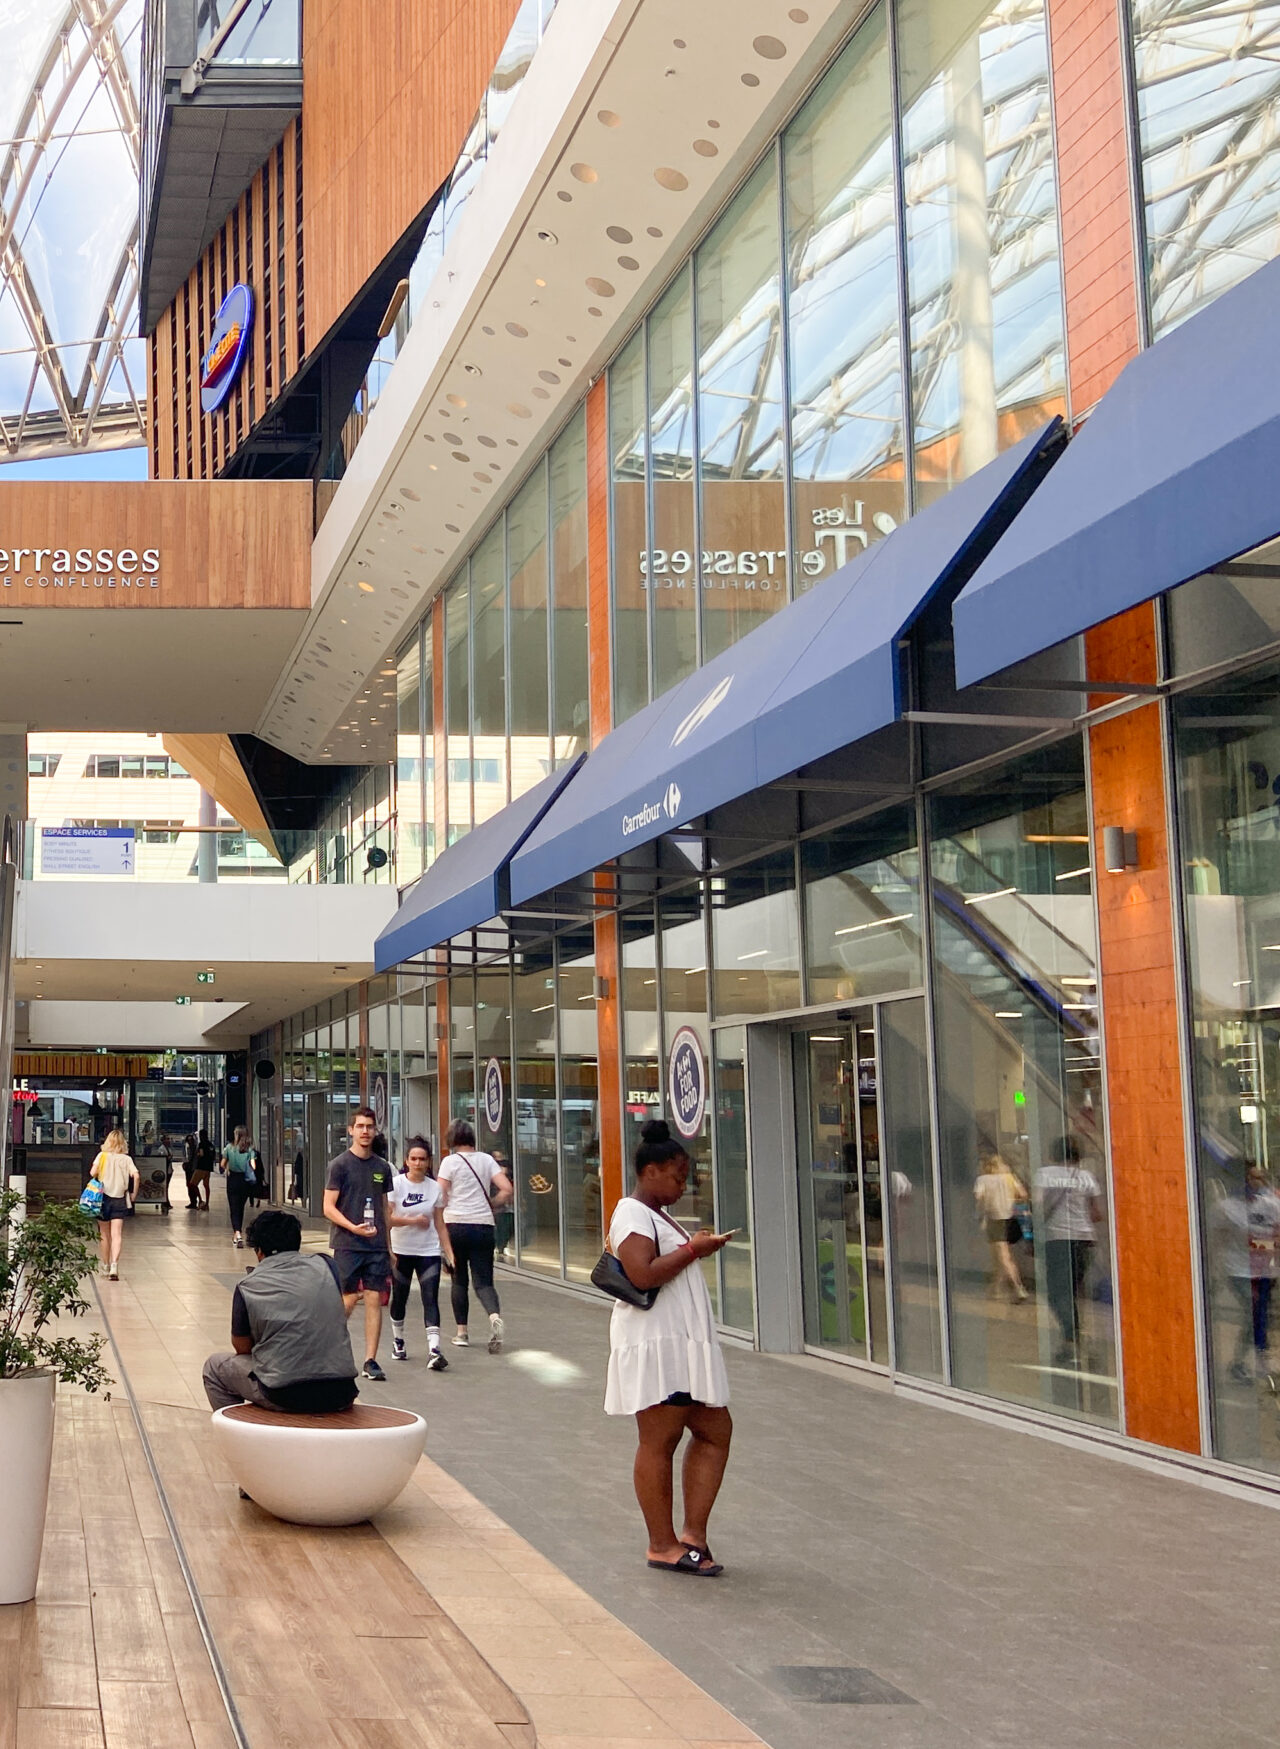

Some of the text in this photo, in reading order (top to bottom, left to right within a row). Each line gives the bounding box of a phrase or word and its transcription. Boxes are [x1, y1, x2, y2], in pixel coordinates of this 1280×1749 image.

[24, 576, 160, 588] CONFLUENCE
[622, 802, 661, 836] Carrefour
[122, 842, 129, 853] 1
[407, 1192, 424, 1201] NIKE
